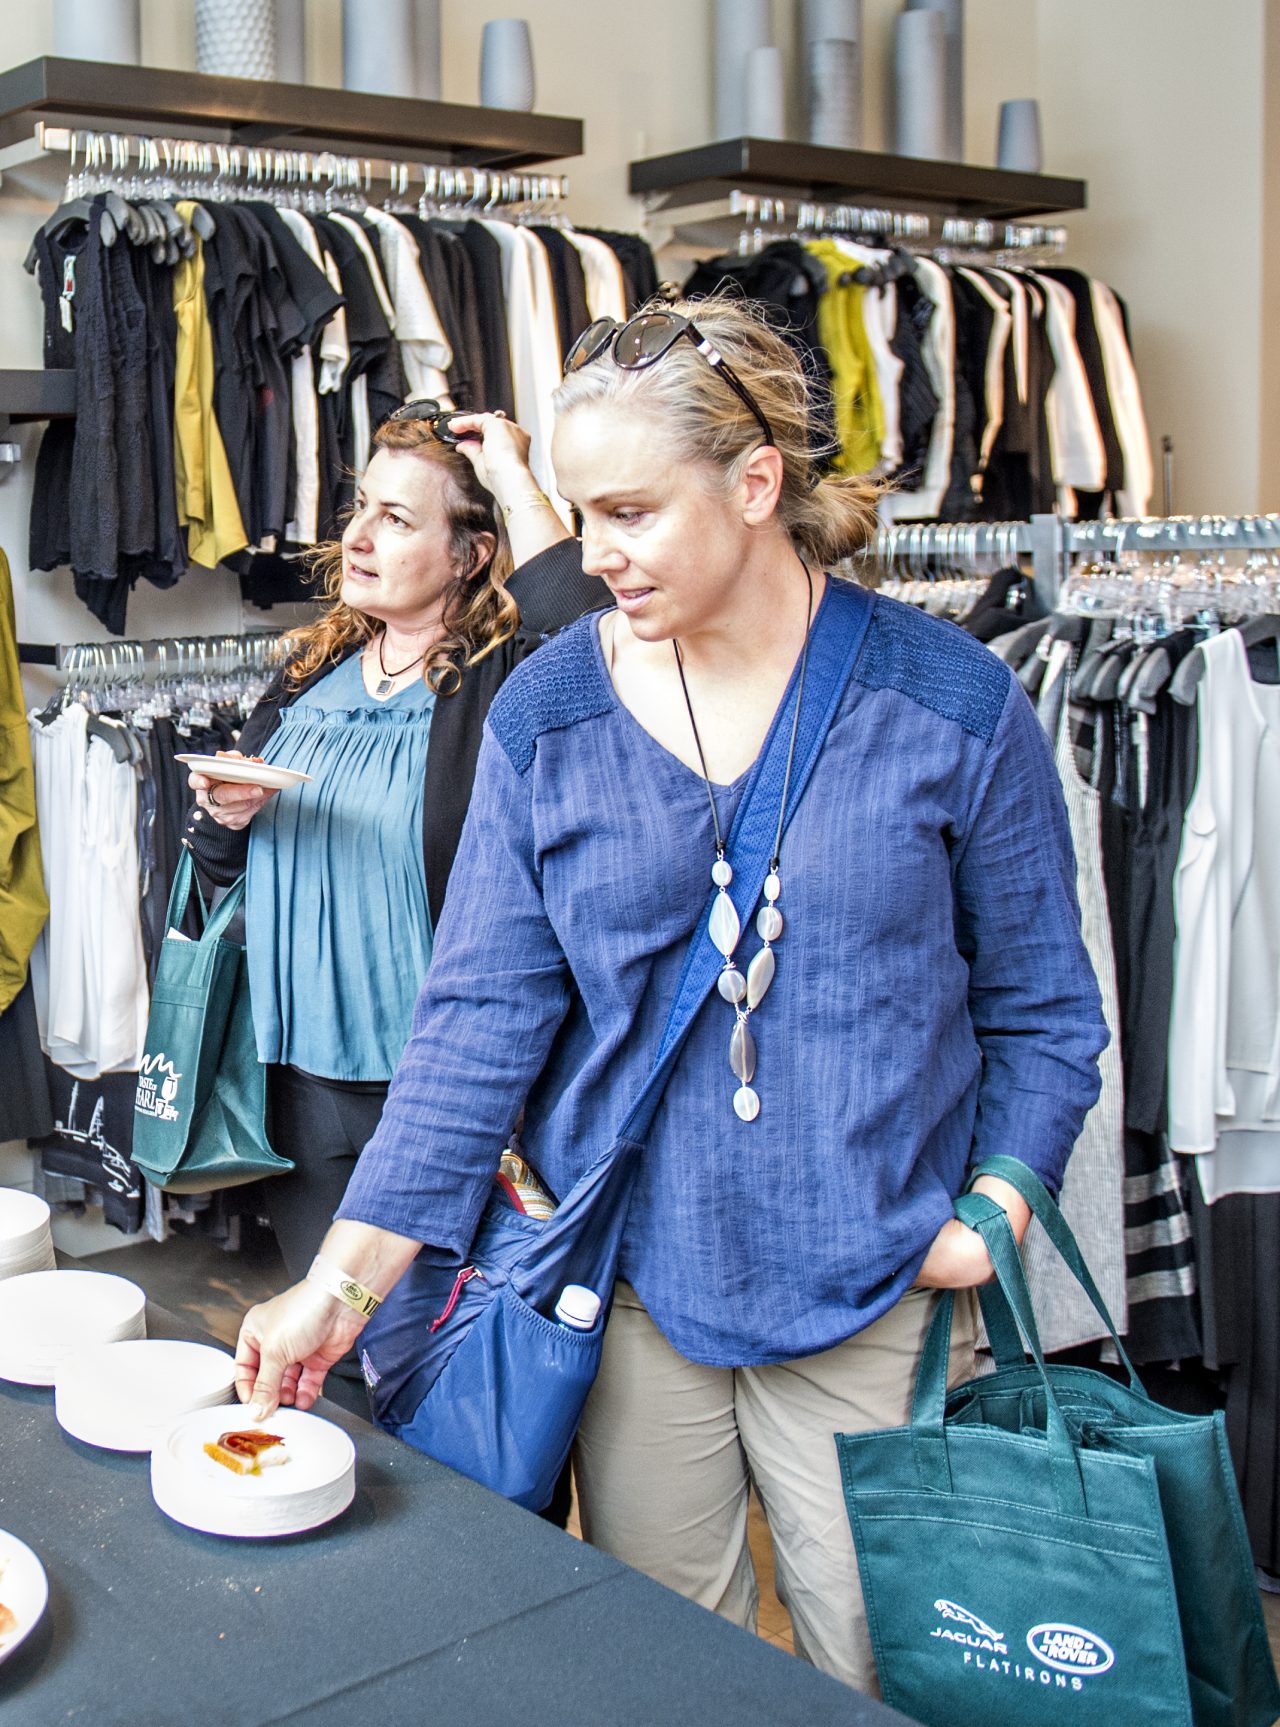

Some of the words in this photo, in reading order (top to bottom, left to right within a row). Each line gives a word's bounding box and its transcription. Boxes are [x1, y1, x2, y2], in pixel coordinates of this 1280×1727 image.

[930, 1627, 1008, 1655] JAGUAR
[1043, 1631, 1086, 1650] LAND
[1047, 1646, 1099, 1666] ROVER
[963, 1651, 1083, 1690] FLATIRONS
